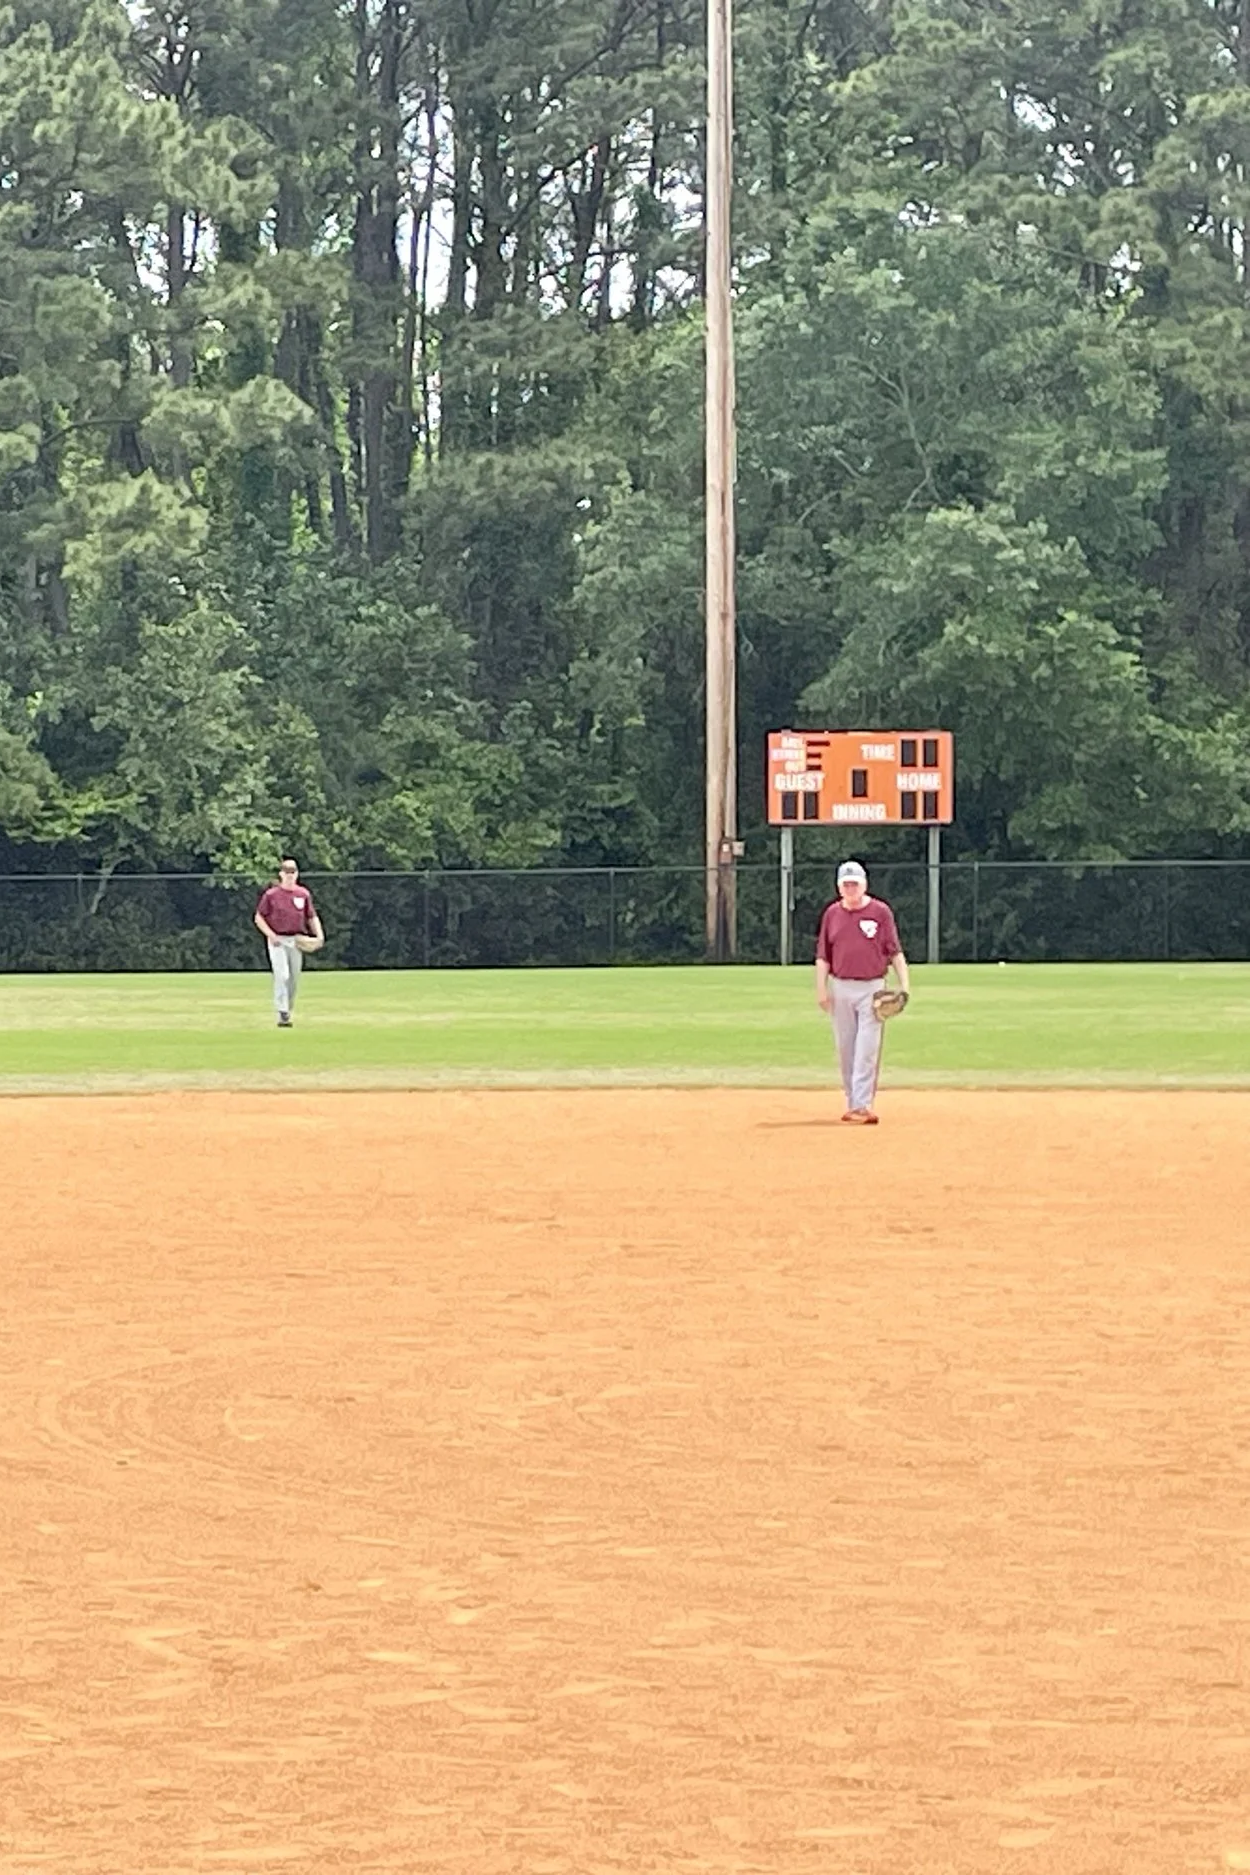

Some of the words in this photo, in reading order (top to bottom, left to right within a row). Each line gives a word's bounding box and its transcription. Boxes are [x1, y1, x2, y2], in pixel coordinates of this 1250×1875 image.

[860, 744, 895, 761] TIME
[774, 773, 825, 791] GUEST
[896, 773, 942, 790] HOME
